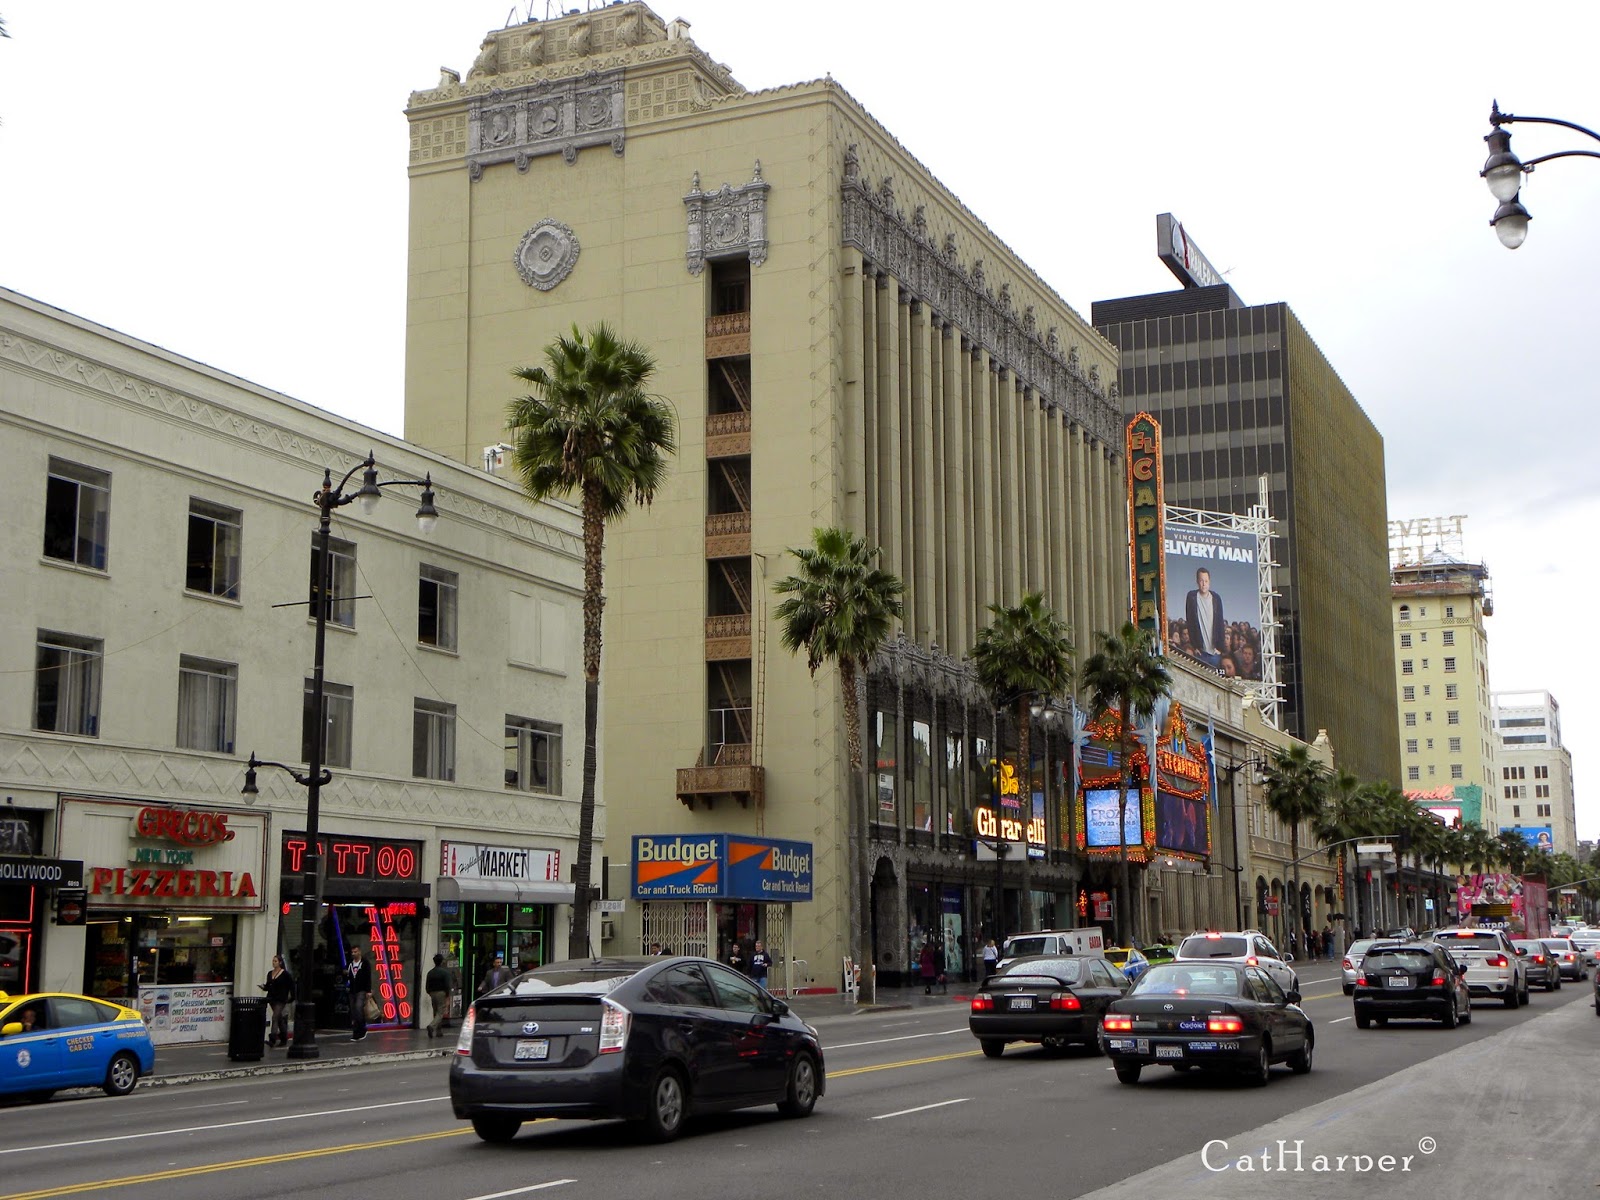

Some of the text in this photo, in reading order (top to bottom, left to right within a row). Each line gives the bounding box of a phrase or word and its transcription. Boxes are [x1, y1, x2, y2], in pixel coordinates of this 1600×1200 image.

[1131, 432, 1157, 454] EL
[1133, 457, 1160, 621] CAPITA
[1165, 539, 1254, 564] ELIVERY MAN
[1174, 533, 1231, 546] VINCE VAUGHN
[1172, 754, 1201, 779] CAPITAN
[136, 806, 236, 848] GRECO'S
[977, 807, 1046, 845] Ghrarelli
[1091, 808, 1138, 821] FROZN
[135, 848, 194, 864] NEW YORK
[287, 840, 415, 877] TTTOO
[480, 850, 528, 878] MARKET
[638, 838, 718, 866] Budget
[772, 847, 810, 877] Budget
[0, 863, 62, 880] HOLLYWOOD
[89, 866, 258, 898] PIZZERIA
[637, 884, 718, 895] Car and Truck Rental
[762, 879, 810, 893] Car and Truck Rental
[365, 907, 397, 1019] TATTOO
[381, 907, 411, 1019] TATTOO
[192, 989, 213, 998] PIZZA
[66, 1036, 95, 1046] CHECKER
[69, 1043, 94, 1053] CAB CO.
